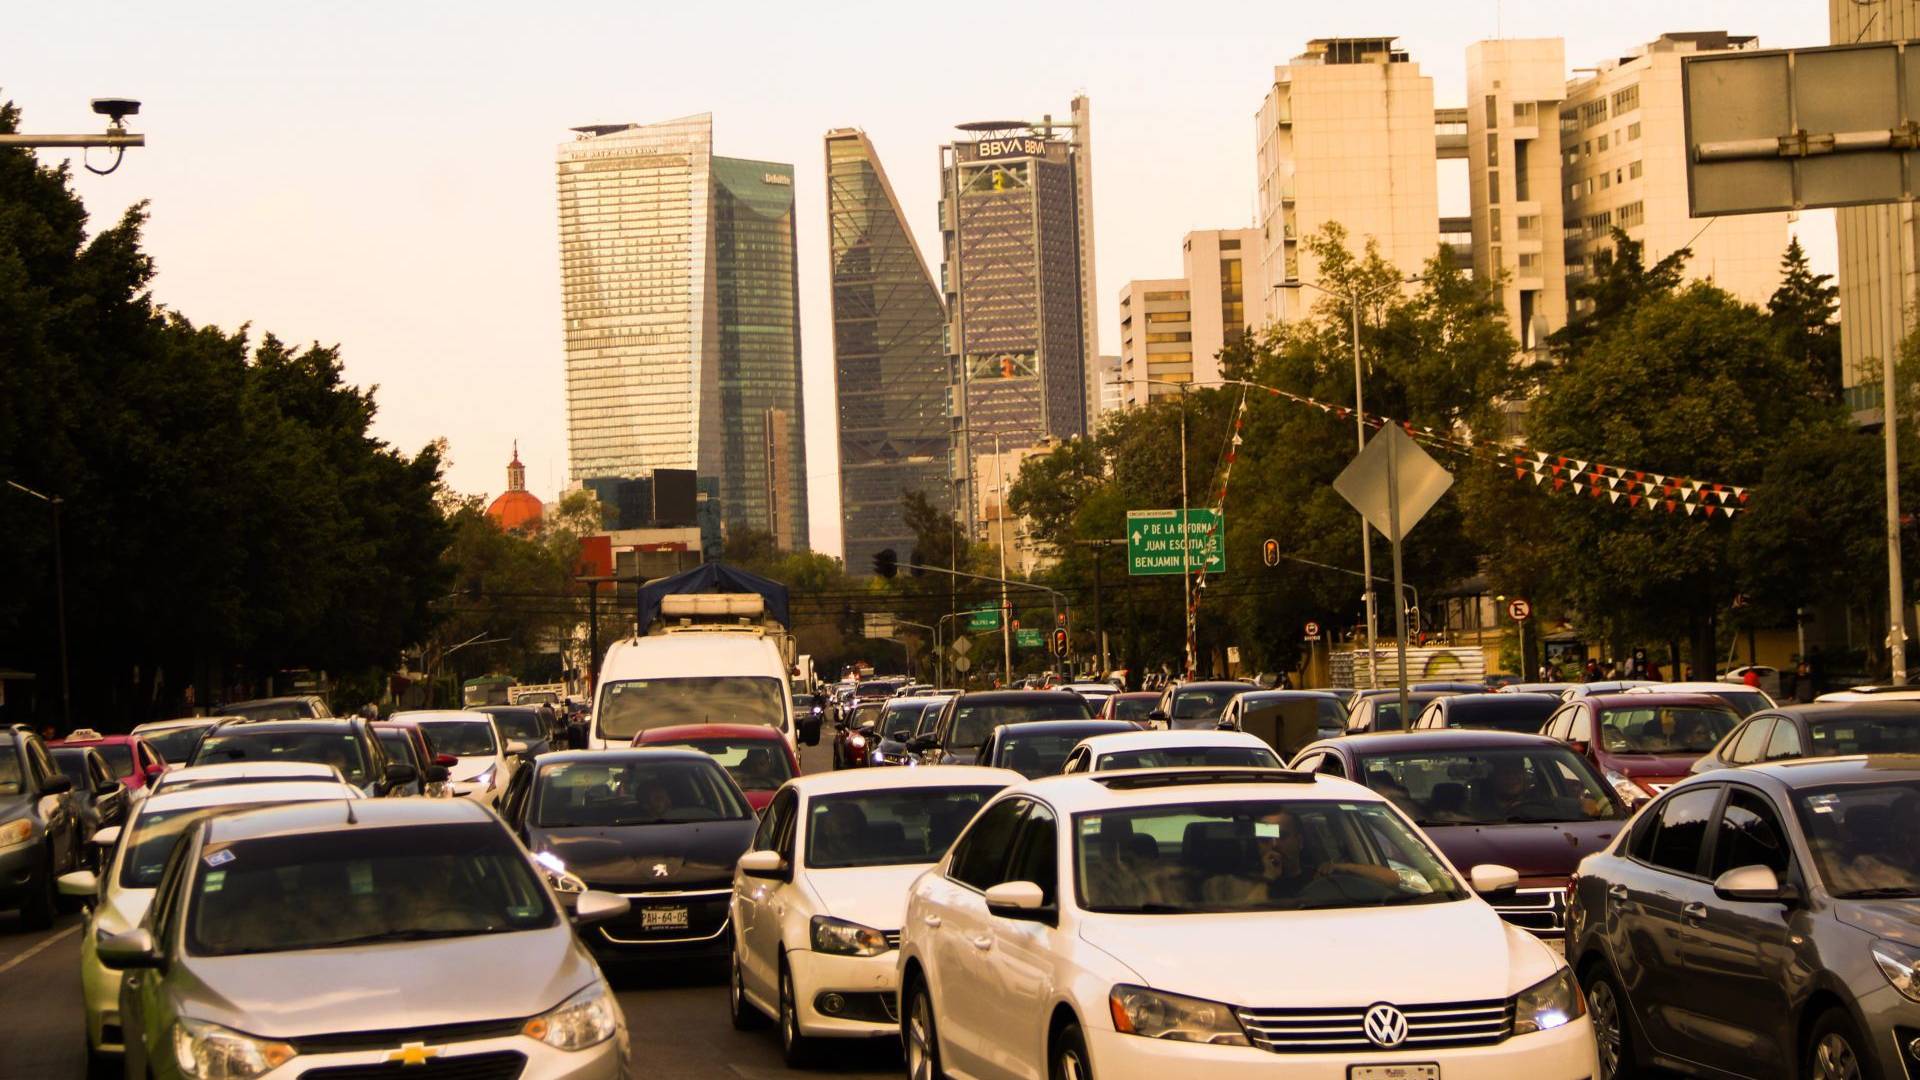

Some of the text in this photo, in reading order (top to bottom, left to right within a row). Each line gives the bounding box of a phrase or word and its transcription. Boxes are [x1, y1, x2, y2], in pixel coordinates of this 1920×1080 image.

[979, 139, 1023, 157] BBVA
[1024, 139, 1046, 155] BBVA
[1143, 525, 1149, 535] P
[1151, 524, 1161, 535] DE
[1165, 524, 1175, 535] LA
[1145, 540, 1166, 551] JUAN
[1135, 556, 1180, 568] BENJAMIN
